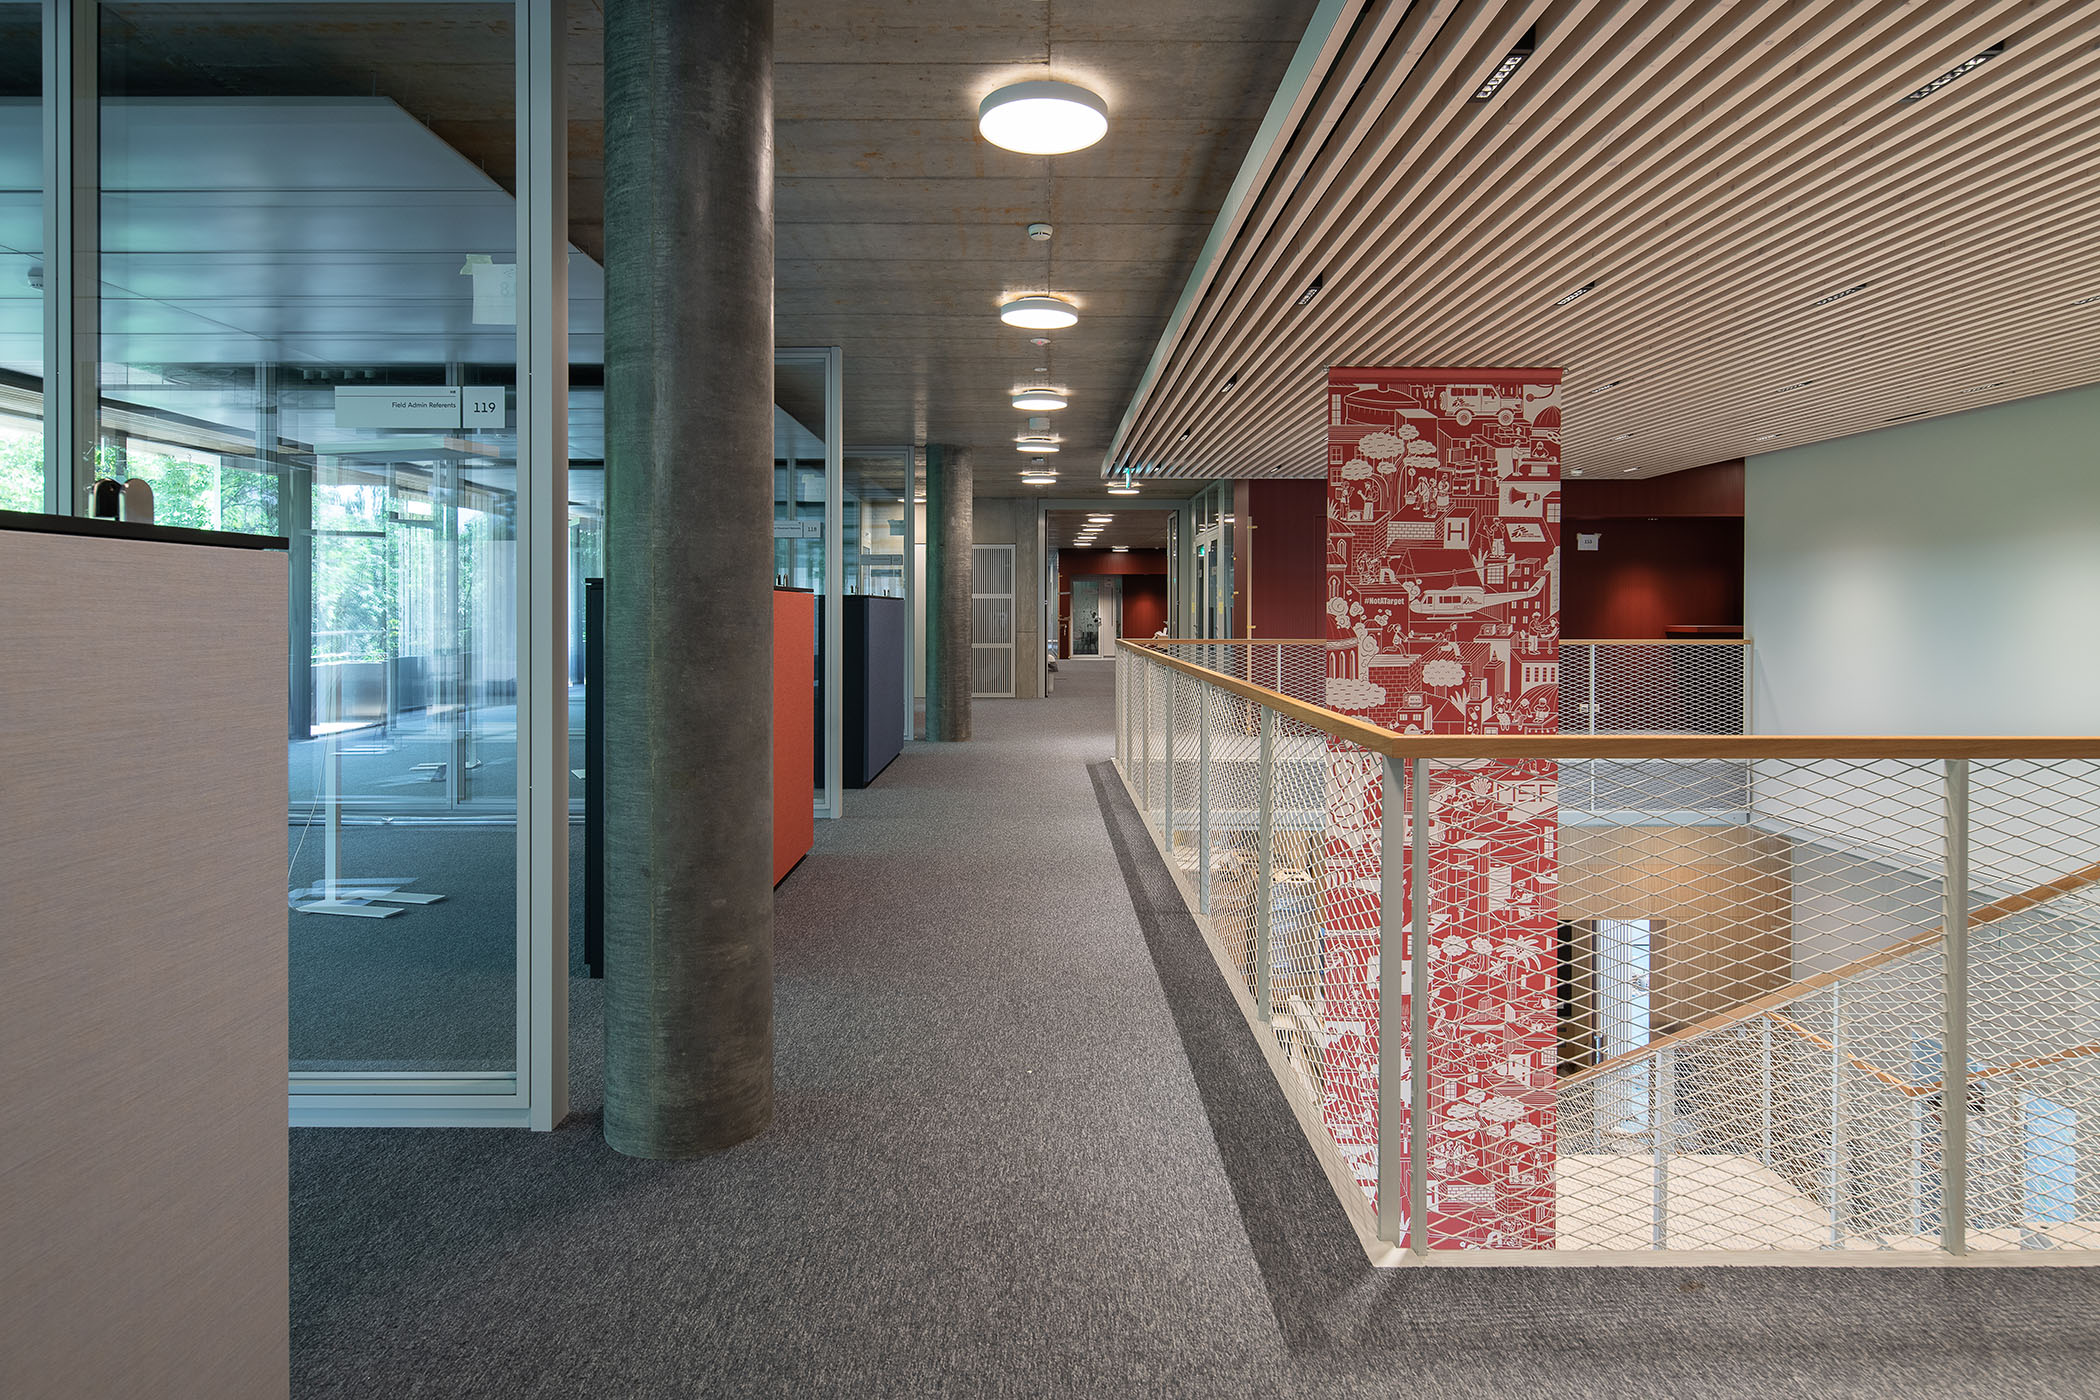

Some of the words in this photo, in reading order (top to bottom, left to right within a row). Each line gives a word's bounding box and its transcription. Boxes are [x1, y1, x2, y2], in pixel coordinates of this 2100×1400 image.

[473, 402, 496, 413] 119
[1447, 522, 1464, 541] H
[1364, 597, 1405, 605] #NotATarget
[1497, 784, 1556, 802] MSF
